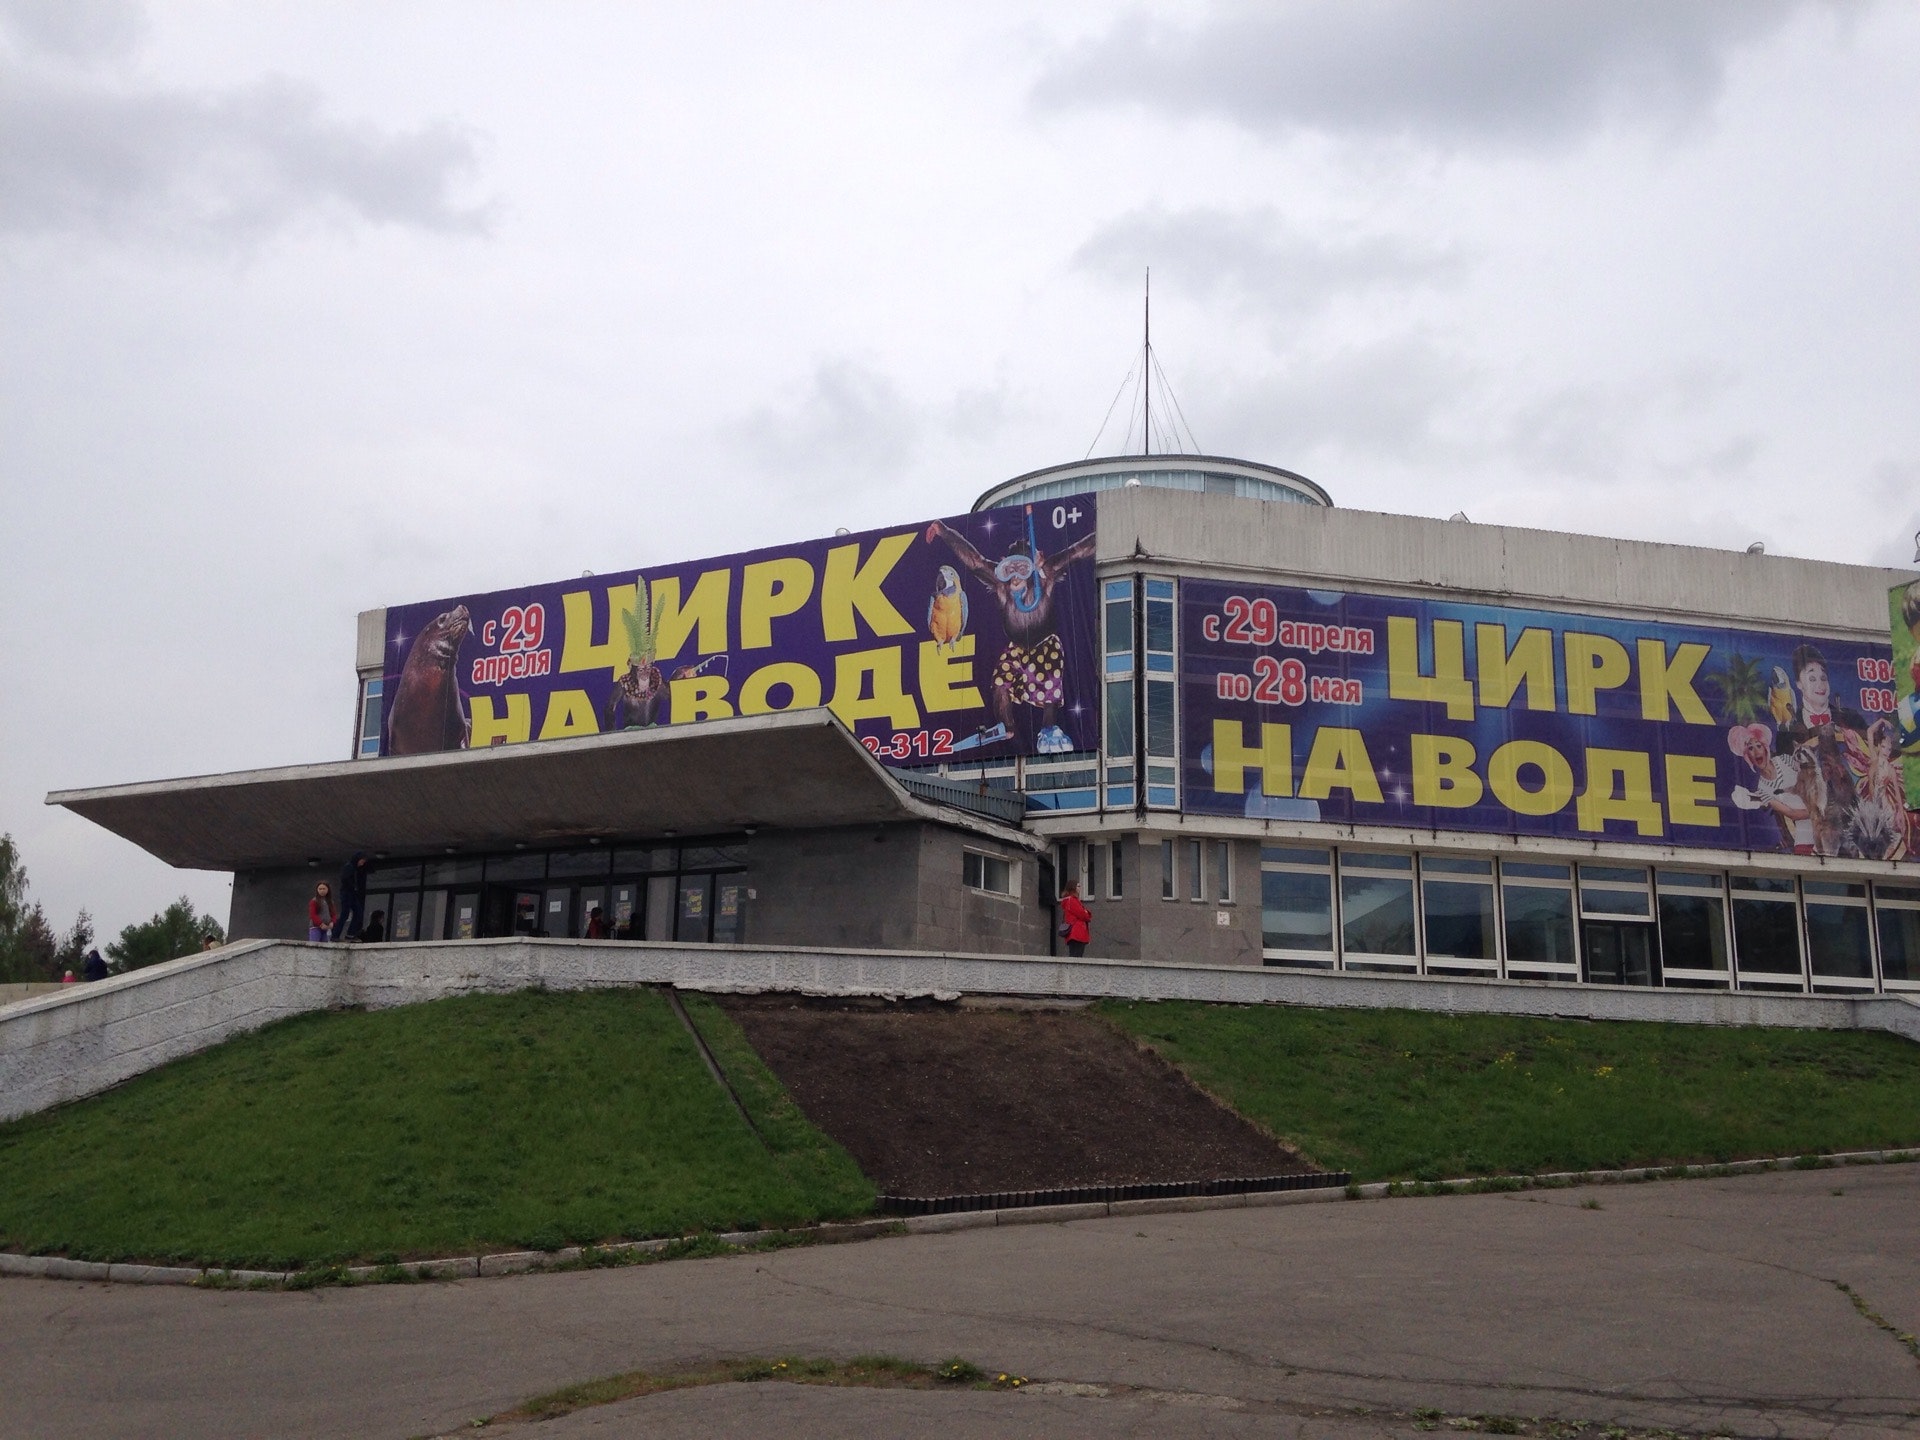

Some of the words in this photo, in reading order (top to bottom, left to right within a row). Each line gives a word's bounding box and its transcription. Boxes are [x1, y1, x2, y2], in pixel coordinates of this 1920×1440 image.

[1052, 505, 1083, 530] 0+
[499, 602, 546, 653] 29
[559, 531, 918, 682] ЦИРК
[1223, 595, 1278, 646] 29
[1279, 618, 1375, 655] апреля
[469, 689, 600, 747] НА
[670, 633, 985, 734] ВОДЕ
[471, 648, 551, 686] апреля
[1216, 672, 1251, 701] по
[1253, 656, 1307, 706] 28
[1310, 675, 1363, 705] мая
[1387, 615, 1717, 726] ЦИРК
[1212, 718, 1386, 804] НА
[1410, 733, 1721, 838] ВОДЕ
